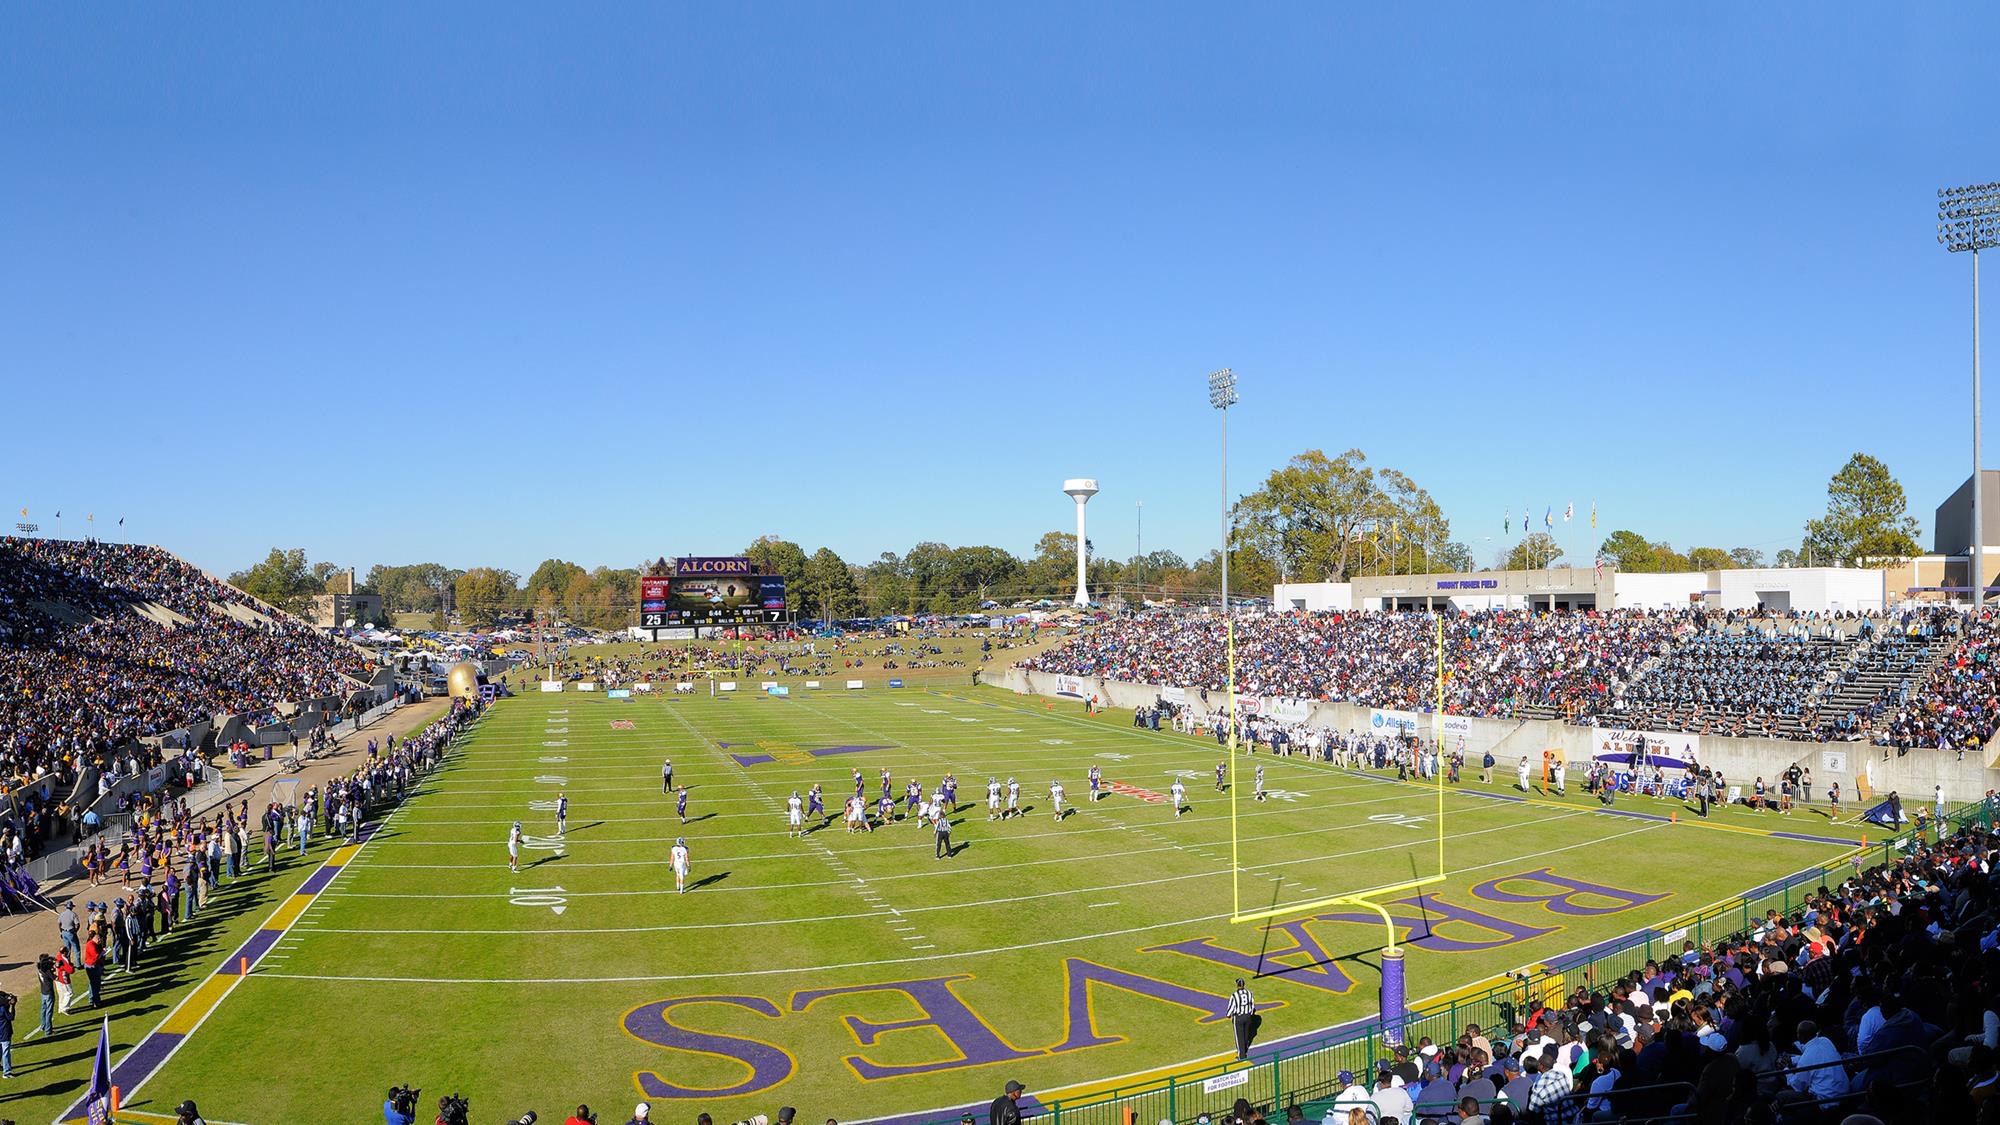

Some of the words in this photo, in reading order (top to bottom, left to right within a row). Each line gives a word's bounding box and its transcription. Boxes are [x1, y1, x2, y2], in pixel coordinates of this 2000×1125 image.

[680, 561, 747, 572] ALCORN
[1437, 582, 1459, 590] DWIGHT
[1460, 581, 1480, 589] FISHER
[1481, 580, 1498, 589] FIELD
[646, 614, 662, 626] 25
[770, 611, 780, 622] 7
[1385, 717, 1416, 730] Allstate
[1444, 720, 1468, 730] sodexo
[1609, 731, 1664, 745] Welcme
[1602, 741, 1670, 755] ALUNI
[677, 851, 682, 859] 5
[509, 885, 568, 906] 10
[621, 866, 1674, 1101] BRAVES
[1240, 993, 1248, 1006] B
[1217, 1077, 1245, 1088] FOOTBALLS
